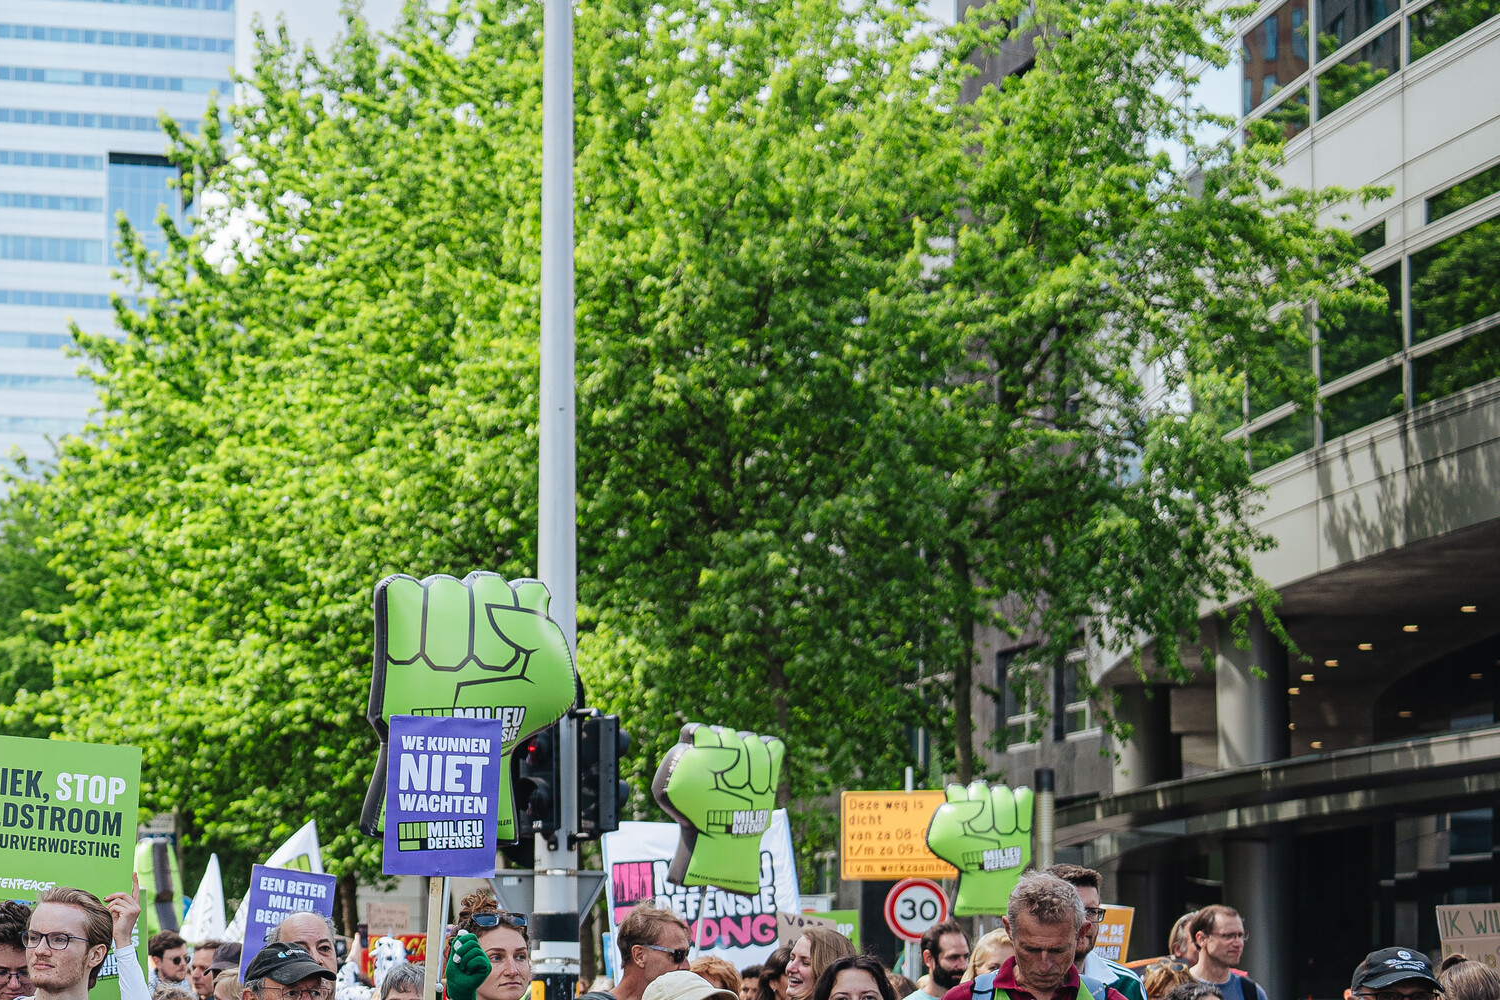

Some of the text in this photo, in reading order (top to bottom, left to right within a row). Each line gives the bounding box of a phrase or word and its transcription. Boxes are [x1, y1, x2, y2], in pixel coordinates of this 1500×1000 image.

[401, 735, 491, 754] WE KUNNEN
[398, 753, 490, 794] NIET
[55, 771, 127, 805] STOP
[398, 793, 488, 815] WACHTEN
[849, 799, 924, 812] Deze weg is
[427, 820, 483, 838] MILIEU
[849, 814, 883, 825] dicht
[427, 836, 484, 850] DEFENSIE
[849, 831, 870, 841] van
[877, 831, 891, 841] za
[259, 876, 327, 898] EEN BETER
[268, 894, 314, 912] MILIEU
[900, 898, 938, 921] 30
[690, 914, 778, 947] ONG
[837, 923, 855, 936] OP
[1442, 909, 1464, 937] IK
